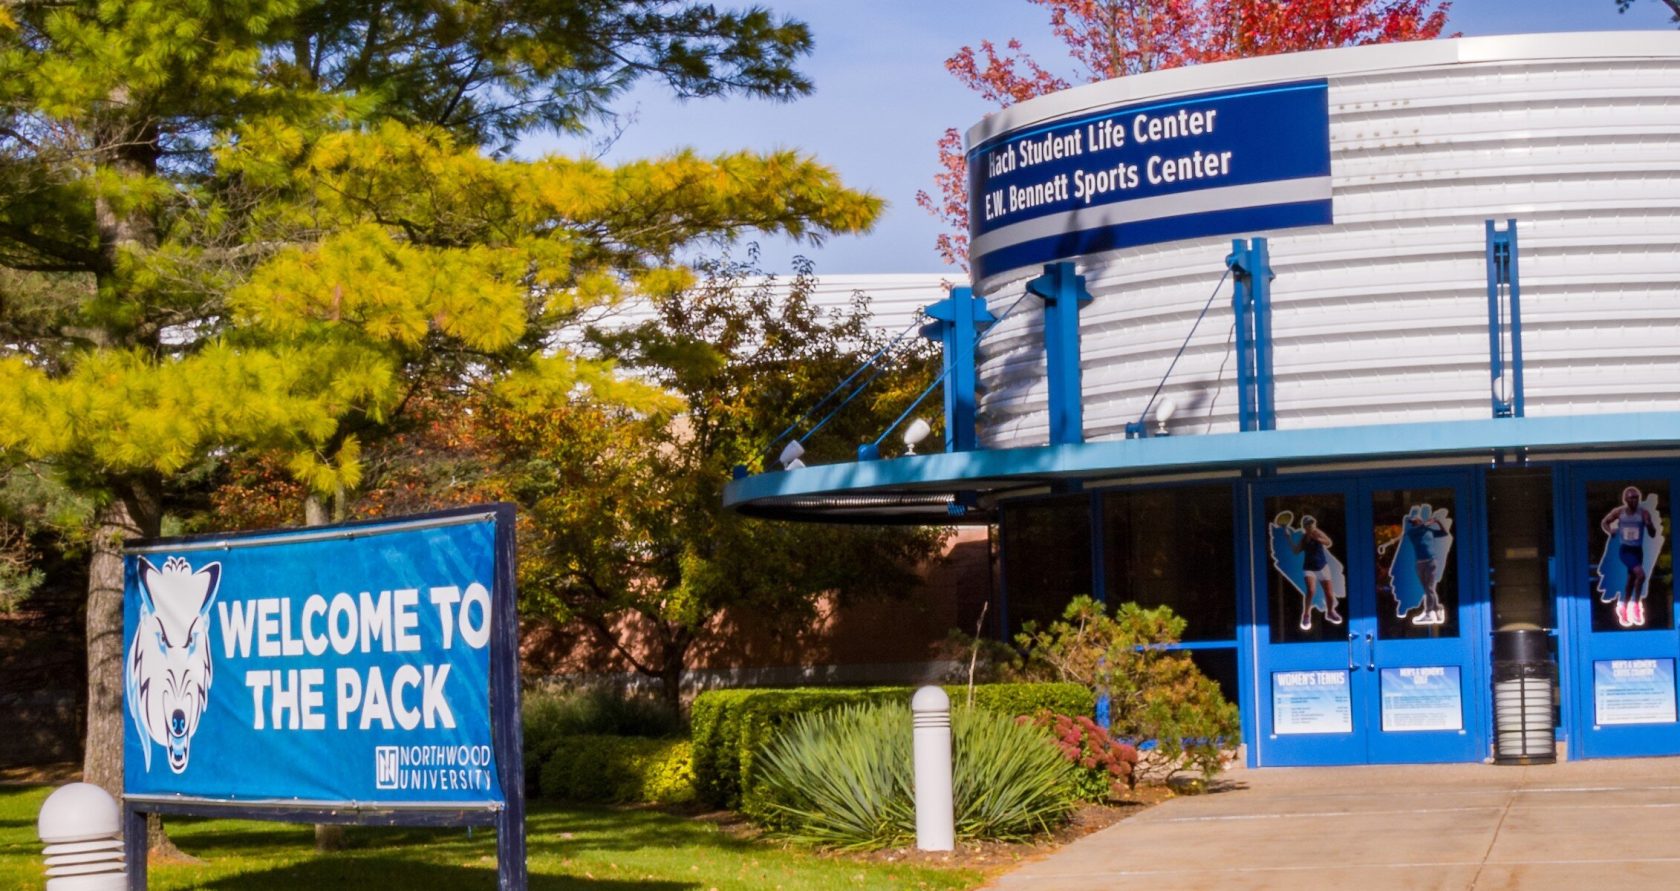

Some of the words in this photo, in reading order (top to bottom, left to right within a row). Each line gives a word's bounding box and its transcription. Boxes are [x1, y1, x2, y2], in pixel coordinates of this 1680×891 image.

[988, 144, 1016, 178] Hach
[1019, 128, 1082, 168] Student
[1088, 119, 1125, 152] Life
[1133, 108, 1217, 144] Center
[985, 189, 1007, 221] E.W.
[1009, 173, 1069, 213] Bennett
[1074, 162, 1139, 204] Sports
[1147, 150, 1232, 185] Center
[217, 587, 421, 659] WELCOME
[430, 582, 492, 650] TO
[245, 668, 326, 731] THE
[336, 663, 457, 731] PACK
[1278, 672, 1315, 687] WOMEN'S
[1316, 670, 1345, 686] TENNIS
[400, 745, 491, 767] NORTHWOOD
[400, 769, 491, 791] UNIVERSITY
